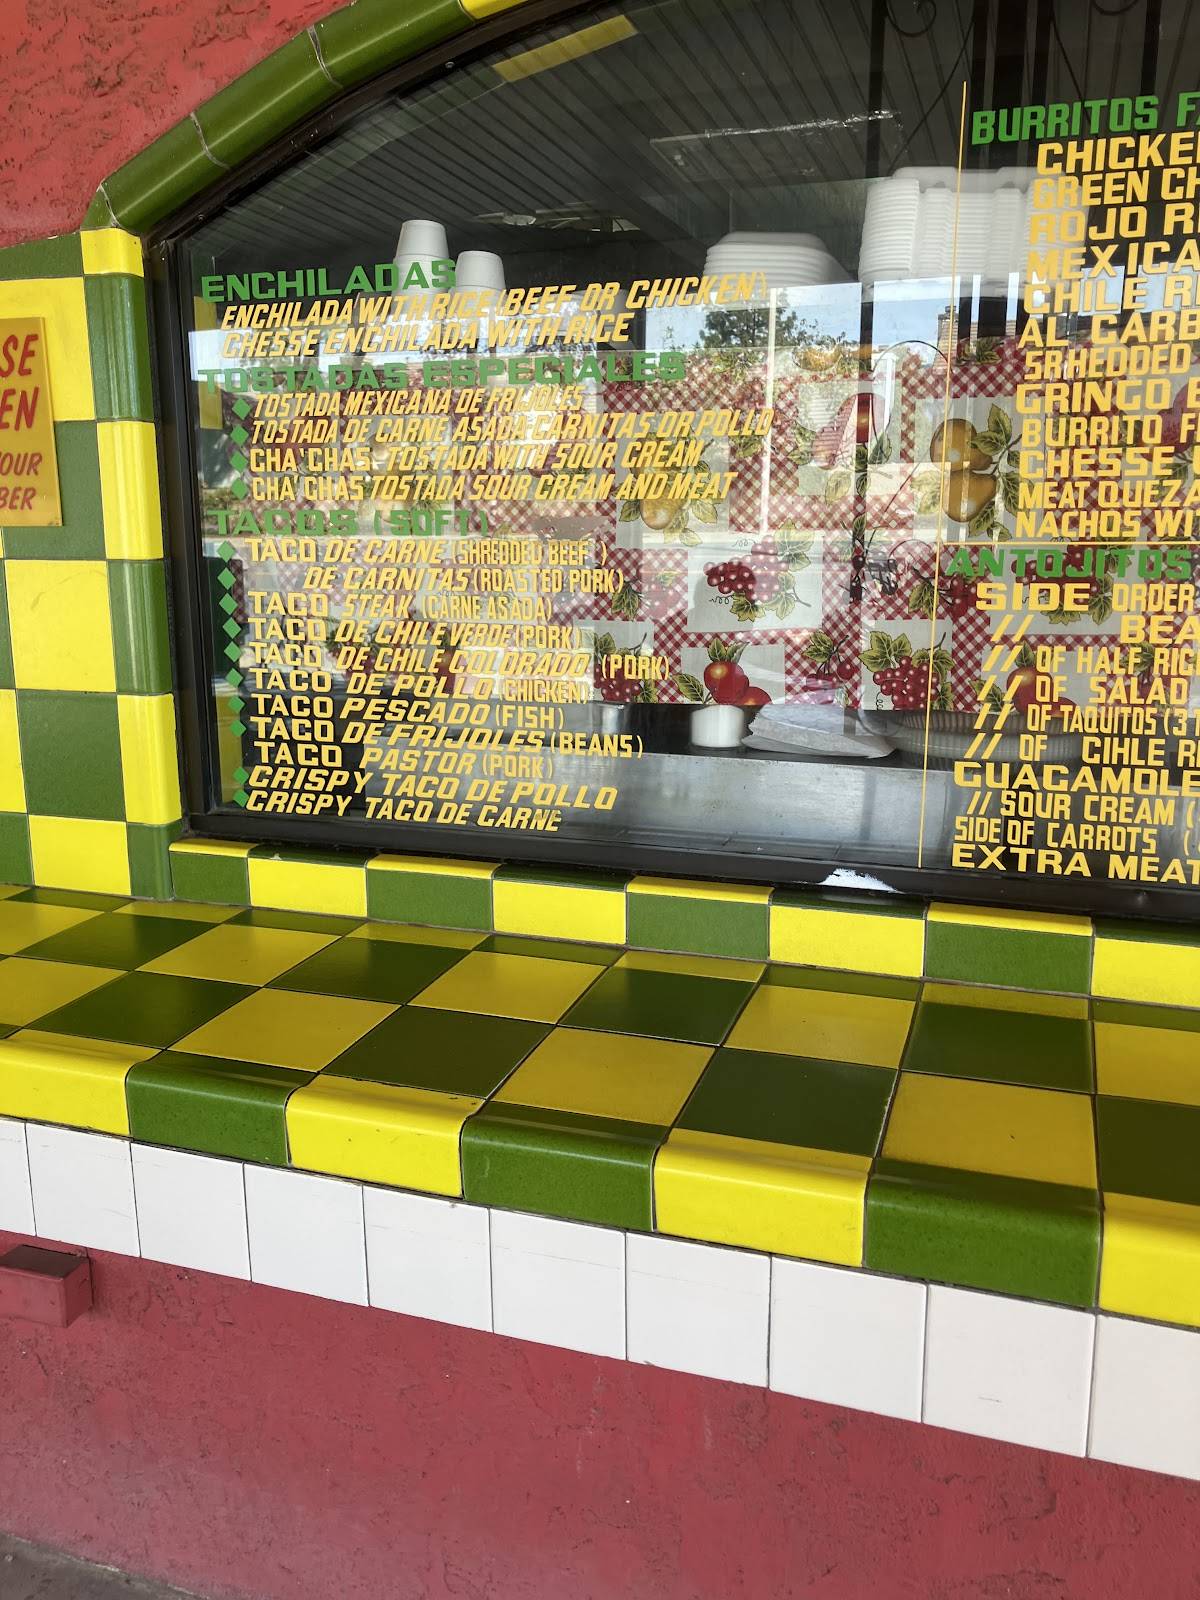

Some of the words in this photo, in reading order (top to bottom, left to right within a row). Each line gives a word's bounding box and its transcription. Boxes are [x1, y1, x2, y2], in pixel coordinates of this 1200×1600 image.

[971, 95, 1159, 145] BURRITOS
[1177, 91, 1200, 127] F
[1037, 131, 1200, 175] CHICKE
[1032, 170, 1150, 209] GREEN
[1029, 206, 1147, 244] ROJO
[1163, 202, 1200, 236] R
[201, 259, 456, 302] ENCHILADAS
[1023, 277, 1148, 314] CHILE
[1164, 275, 1200, 308] R
[221, 299, 353, 330] ENCHILADA
[358, 294, 428, 325] WITH
[428, 287, 495, 321] RICE
[579, 282, 621, 312] OR
[222, 329, 321, 359] CHESSE
[323, 318, 480, 353] ENCHILADA
[487, 319, 560, 347] WITH
[563, 312, 635, 344] RICE
[1018, 316, 1069, 350] AL
[198, 362, 409, 394] TOSTADAS
[422, 350, 688, 387] ESPECIALES
[1024, 343, 1192, 380] SRHEDDED
[253, 391, 342, 419] TOSTADA
[342, 387, 454, 415] MEXICANA
[454, 387, 485, 414] DE
[485, 384, 586, 413] FRIJOLES
[1015, 378, 1171, 414] GRINGO
[251, 419, 340, 445] TOSTADA
[341, 418, 373, 443] DE
[375, 416, 449, 443] CARNE
[451, 415, 527, 442] ASADA
[530, 411, 652, 441] CARNITAS
[655, 411, 695, 438] OR
[698, 408, 776, 437] POLLO
[1021, 414, 1163, 447] BURRITO
[1180, 412, 1200, 443] F
[0, 451, 43, 477] OUR
[387, 444, 489, 473] TOSTADA
[492, 442, 548, 470] WITH
[550, 442, 618, 469] SOUR
[621, 440, 706, 468] CREAM
[1019, 446, 1175, 479] CHESSE
[369, 475, 465, 502] TOSTADA
[468, 474, 533, 501] SOUR
[534, 473, 617, 500] CREAM
[615, 471, 674, 500] AND
[674, 471, 739, 499] MEAT
[1018, 481, 1091, 509] MEAT
[208, 509, 358, 538] TACOS
[373, 509, 489, 538] (SOFT)
[1015, 510, 1142, 538] NACHOS
[244, 538, 317, 563] TACO
[322, 539, 360, 564] DE
[363, 539, 446, 564] CARNE
[451, 540, 544, 566] (SHREDDED
[946, 549, 1192, 580] ANTOJITOS
[303, 566, 337, 590] DE
[343, 567, 469, 592] CARNITAS
[473, 568, 563, 594] (ROASTED
[568, 569, 624, 595] PORK)
[975, 582, 1091, 612] SIDE
[1111, 583, 1195, 613] ORDER
[247, 590, 329, 617] TACO
[341, 594, 414, 618] STEAK
[421, 594, 481, 620] (CARNE
[486, 597, 552, 622] ASADA)
[247, 617, 327, 641] TACO
[335, 619, 373, 643] DE
[374, 620, 448, 647] CHILE
[248, 642, 323, 668] TACO
[335, 646, 371, 670] DE
[373, 647, 446, 673] CHILE
[448, 650, 591, 677] COLORADO
[602, 655, 670, 680] (PORK)
[1035, 645, 1067, 672] OF
[1077, 647, 1142, 674] HALF
[249, 668, 332, 693] TACO
[346, 672, 387, 696] DE
[391, 674, 494, 700] POLLO
[500, 678, 589, 705] (CHICKEN)
[1035, 675, 1068, 703] OF
[1088, 676, 1188, 705] SALAD
[250, 694, 334, 719] TACO
[339, 697, 491, 726] PESCADO
[495, 705, 565, 730] (FISH)
[1026, 703, 1052, 732] OF
[1059, 705, 1158, 736] TAQUITOS
[250, 717, 335, 743] TACO
[340, 721, 386, 745] DE
[387, 724, 546, 753] FRIJOLES
[550, 731, 644, 760] (BEANS)
[1019, 734, 1048, 761] OF
[1082, 737, 1166, 767] CIHLE
[1177, 739, 1200, 768] R
[253, 742, 342, 767] TACO
[359, 748, 478, 776] PASTOR
[481, 754, 554, 779] (PORK)
[248, 766, 373, 794] CRISPY
[382, 774, 461, 800] TACO
[465, 778, 508, 803] DE
[510, 780, 618, 811] POLLO
[245, 791, 353, 817] CRISPY
[365, 797, 434, 824] TACO
[436, 802, 473, 826] DE
[476, 804, 562, 832] CARNE
[1000, 790, 1072, 820] SOUR
[1084, 795, 1176, 826] CREAM
[954, 816, 1001, 843] SIDE
[1007, 819, 1035, 846] OF
[1046, 822, 1158, 854] CARROTS
[951, 843, 1092, 877] EXTRA
